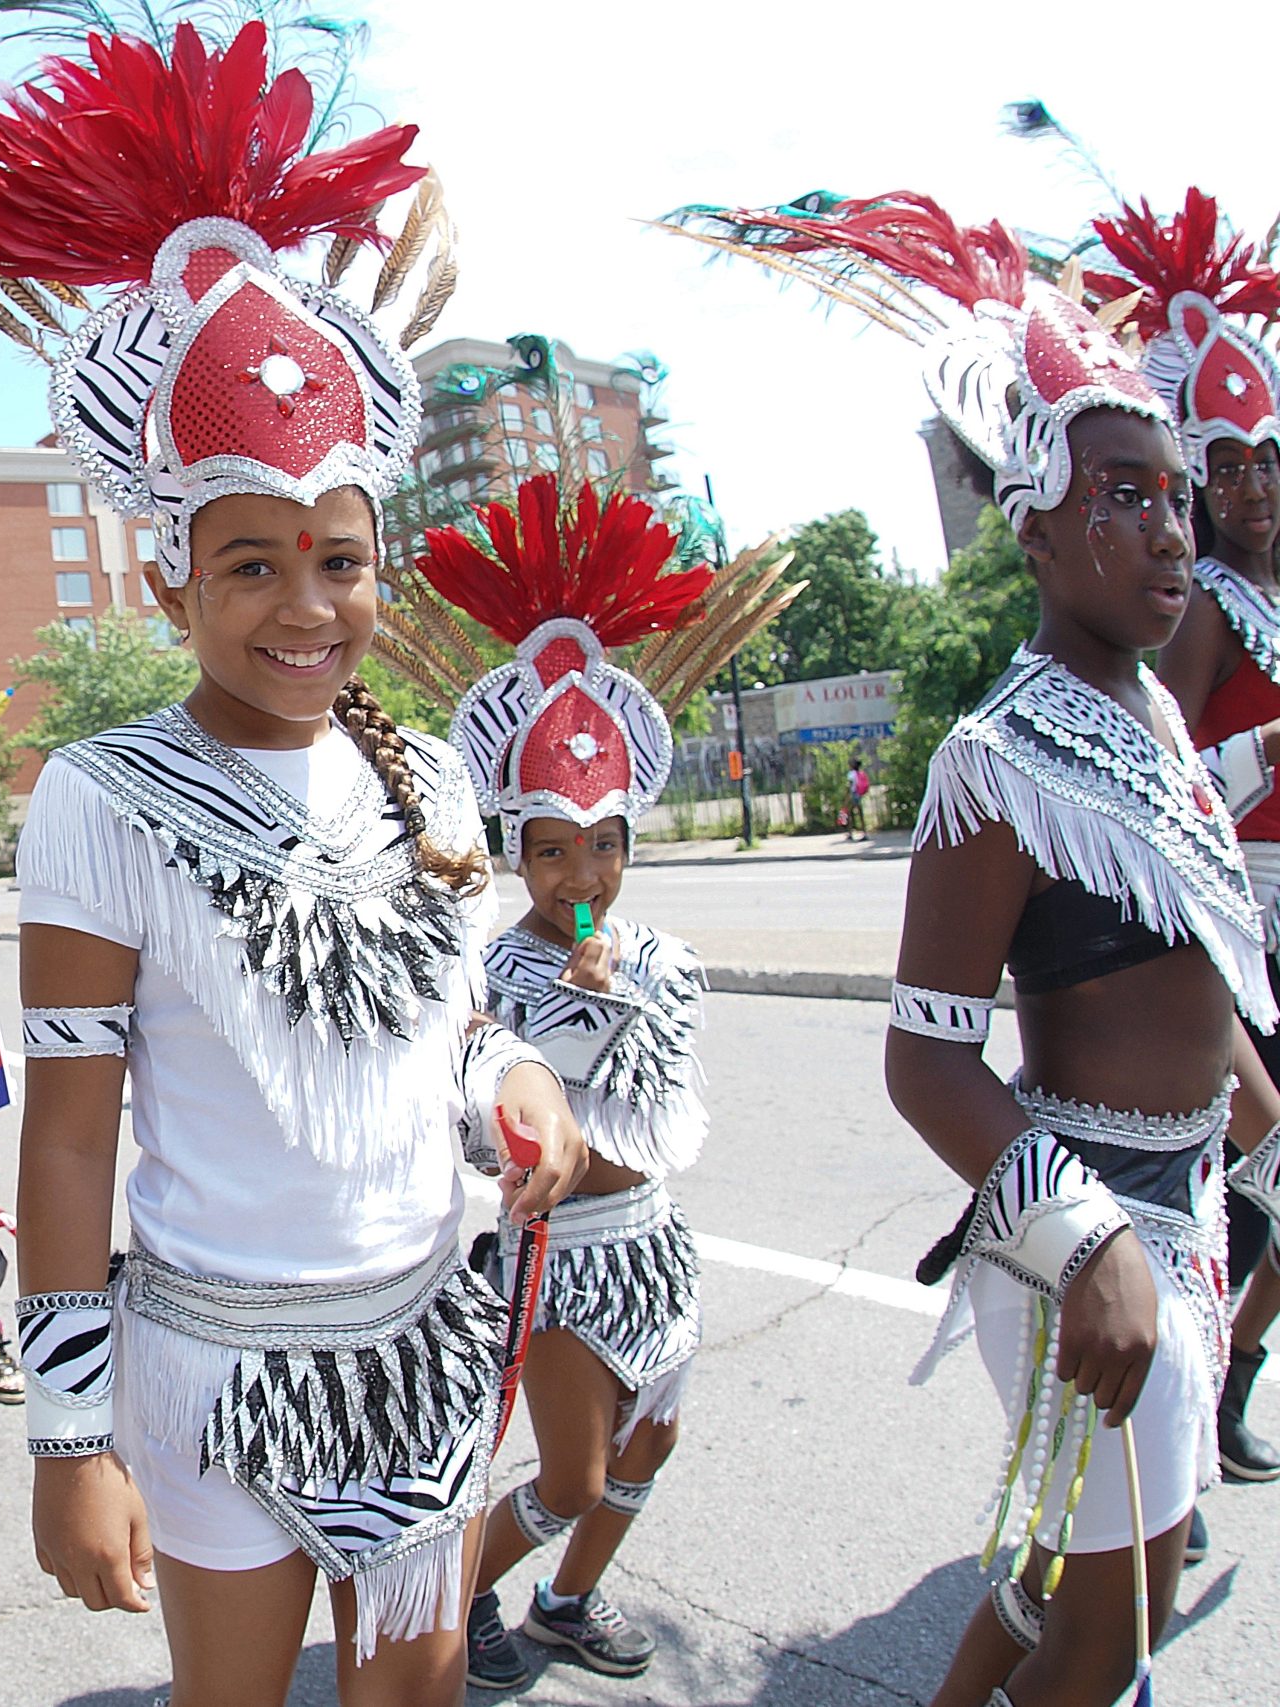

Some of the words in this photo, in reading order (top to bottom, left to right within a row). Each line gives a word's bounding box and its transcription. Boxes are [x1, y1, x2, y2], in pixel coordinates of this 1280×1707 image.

[823, 684, 886, 702] LOUER
[523, 1243, 540, 1286] TOBAGO
[520, 1286, 533, 1309] AND
[511, 1312, 528, 1357] TRINIDAD
